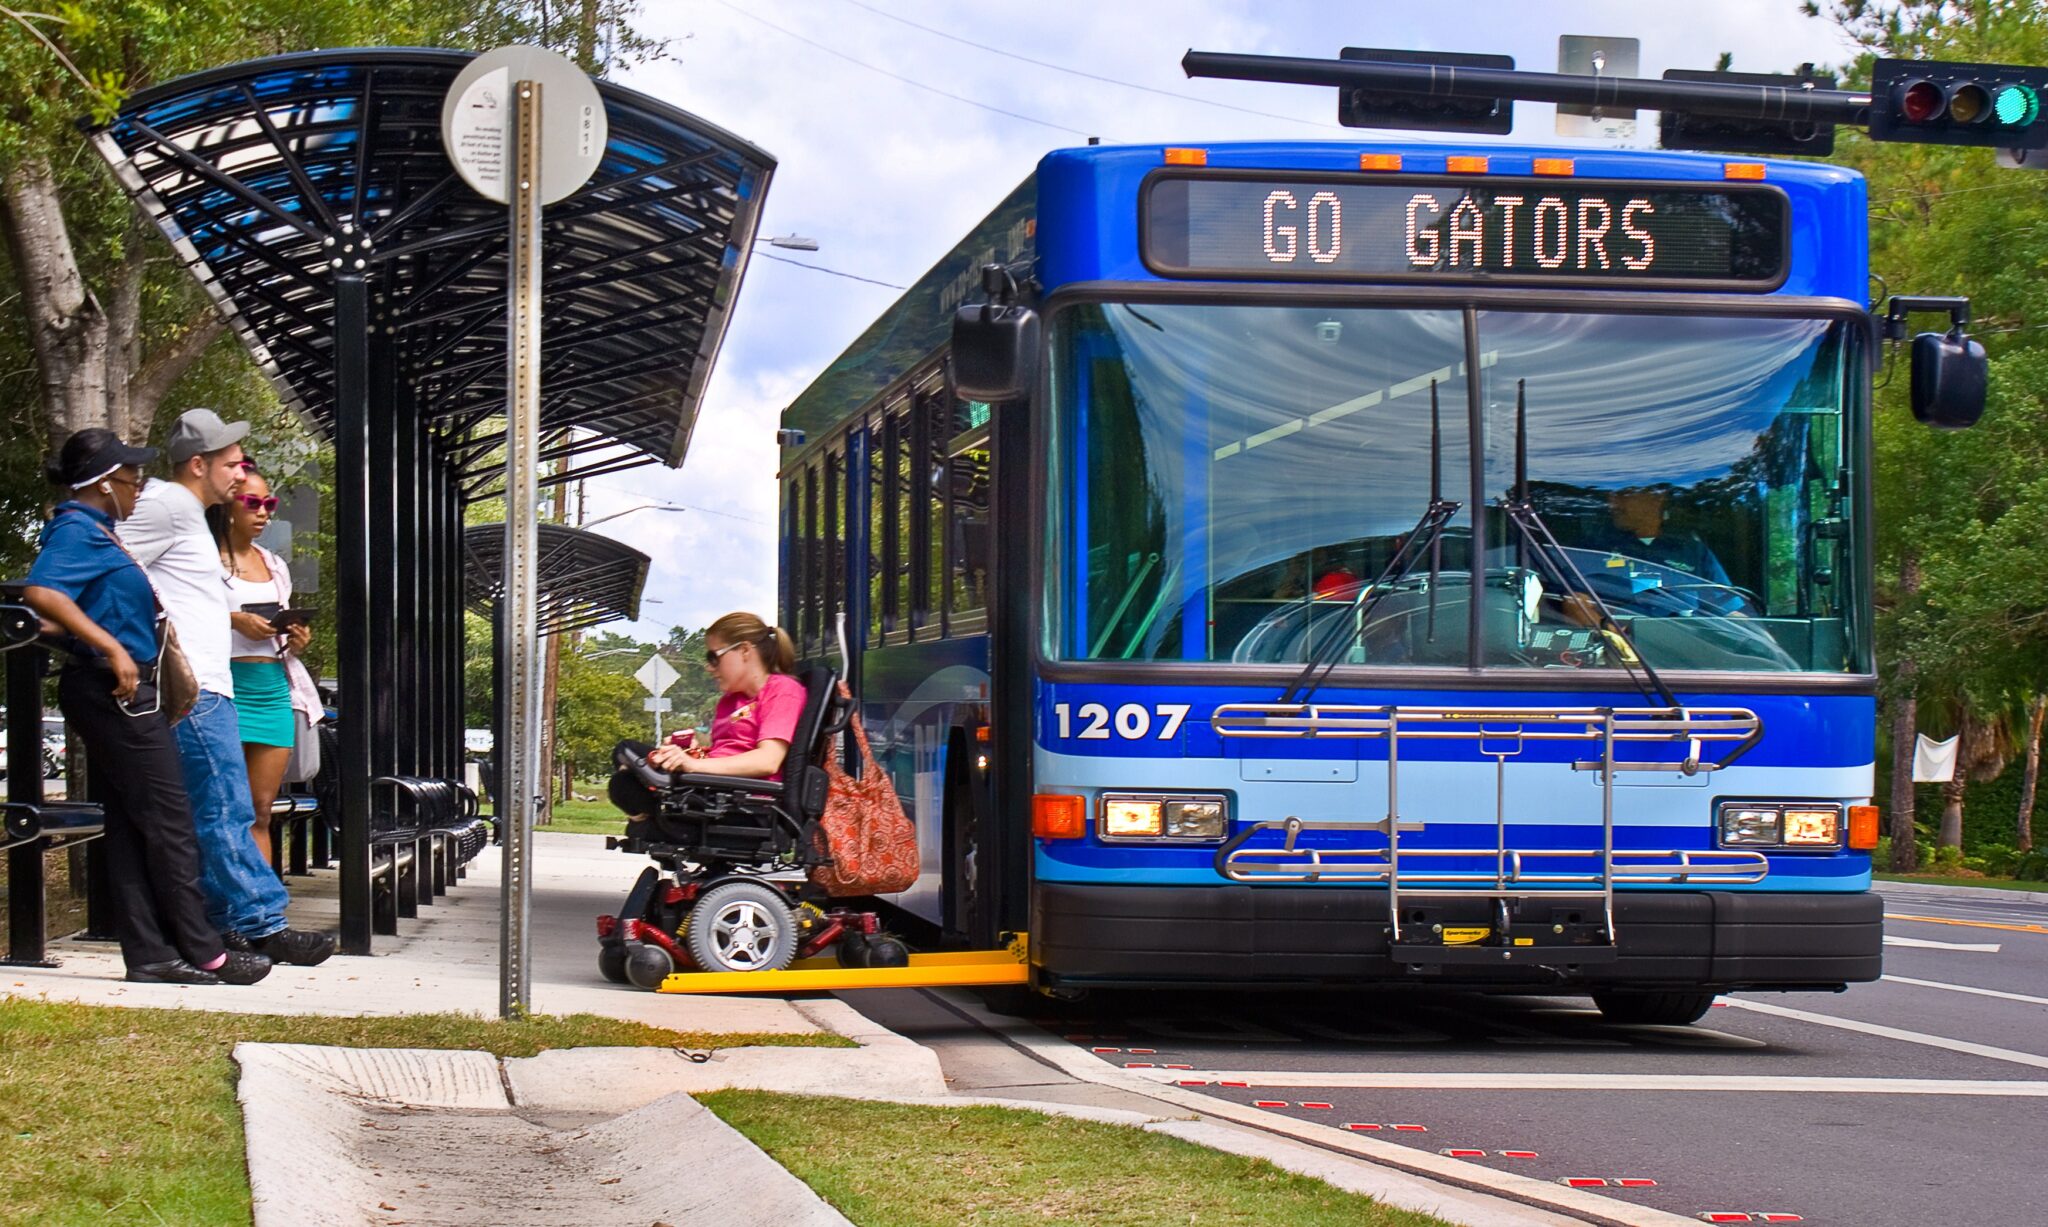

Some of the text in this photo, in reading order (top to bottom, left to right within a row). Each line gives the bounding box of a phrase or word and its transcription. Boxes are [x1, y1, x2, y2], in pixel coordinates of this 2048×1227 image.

[1263, 190, 1656, 271] GO GATORS
[1055, 703, 1191, 740] 1207
